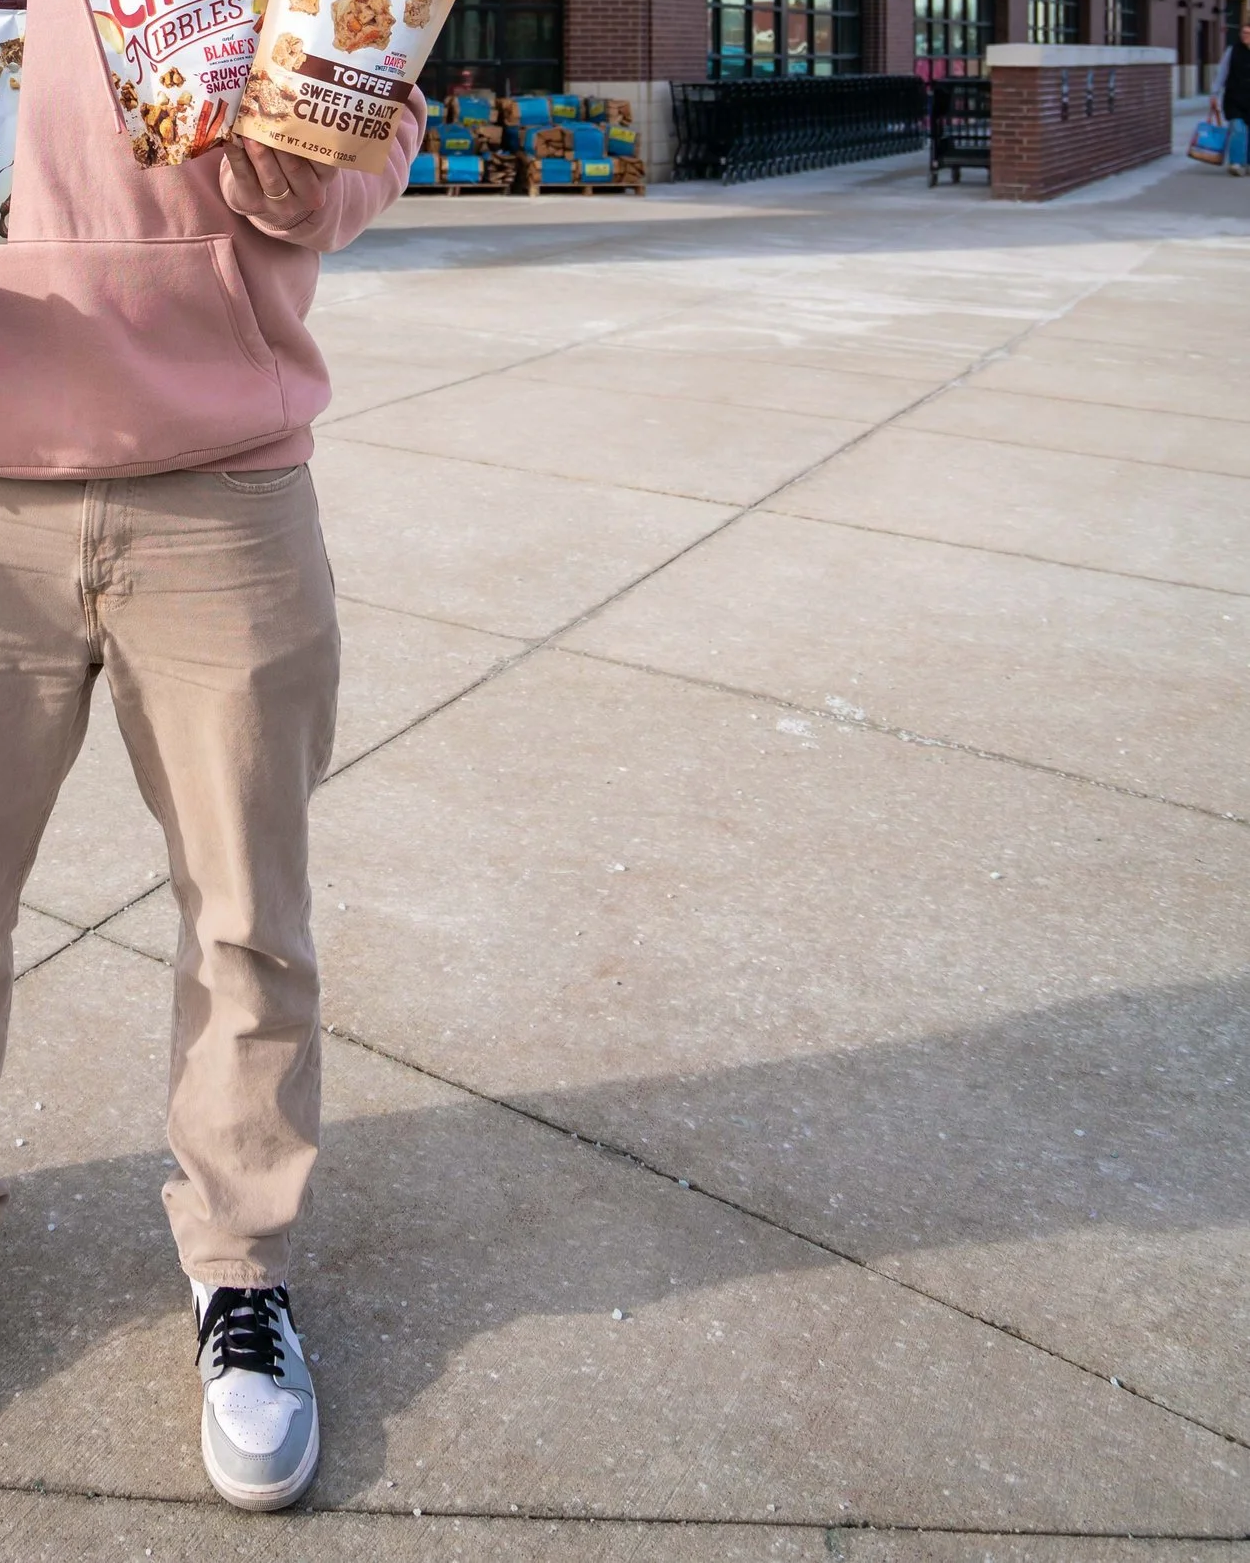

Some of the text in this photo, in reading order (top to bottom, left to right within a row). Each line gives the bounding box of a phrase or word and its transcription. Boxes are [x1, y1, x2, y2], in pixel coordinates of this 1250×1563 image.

[204, 38, 254, 62] BLAKE'S
[222, 34, 234, 42] and
[200, 63, 252, 84] CRUNCH
[333, 66, 393, 96] TOFFEE
[206, 79, 240, 93] SNACK
[300, 82, 398, 119] SWEET & SALTY
[293, 100, 391, 140] CLUSTERS
[269, 131, 285, 141] NET
[287, 137, 299, 146] WT.
[302, 142, 318, 152] 4.25
[320, 147, 332, 156] OZ
